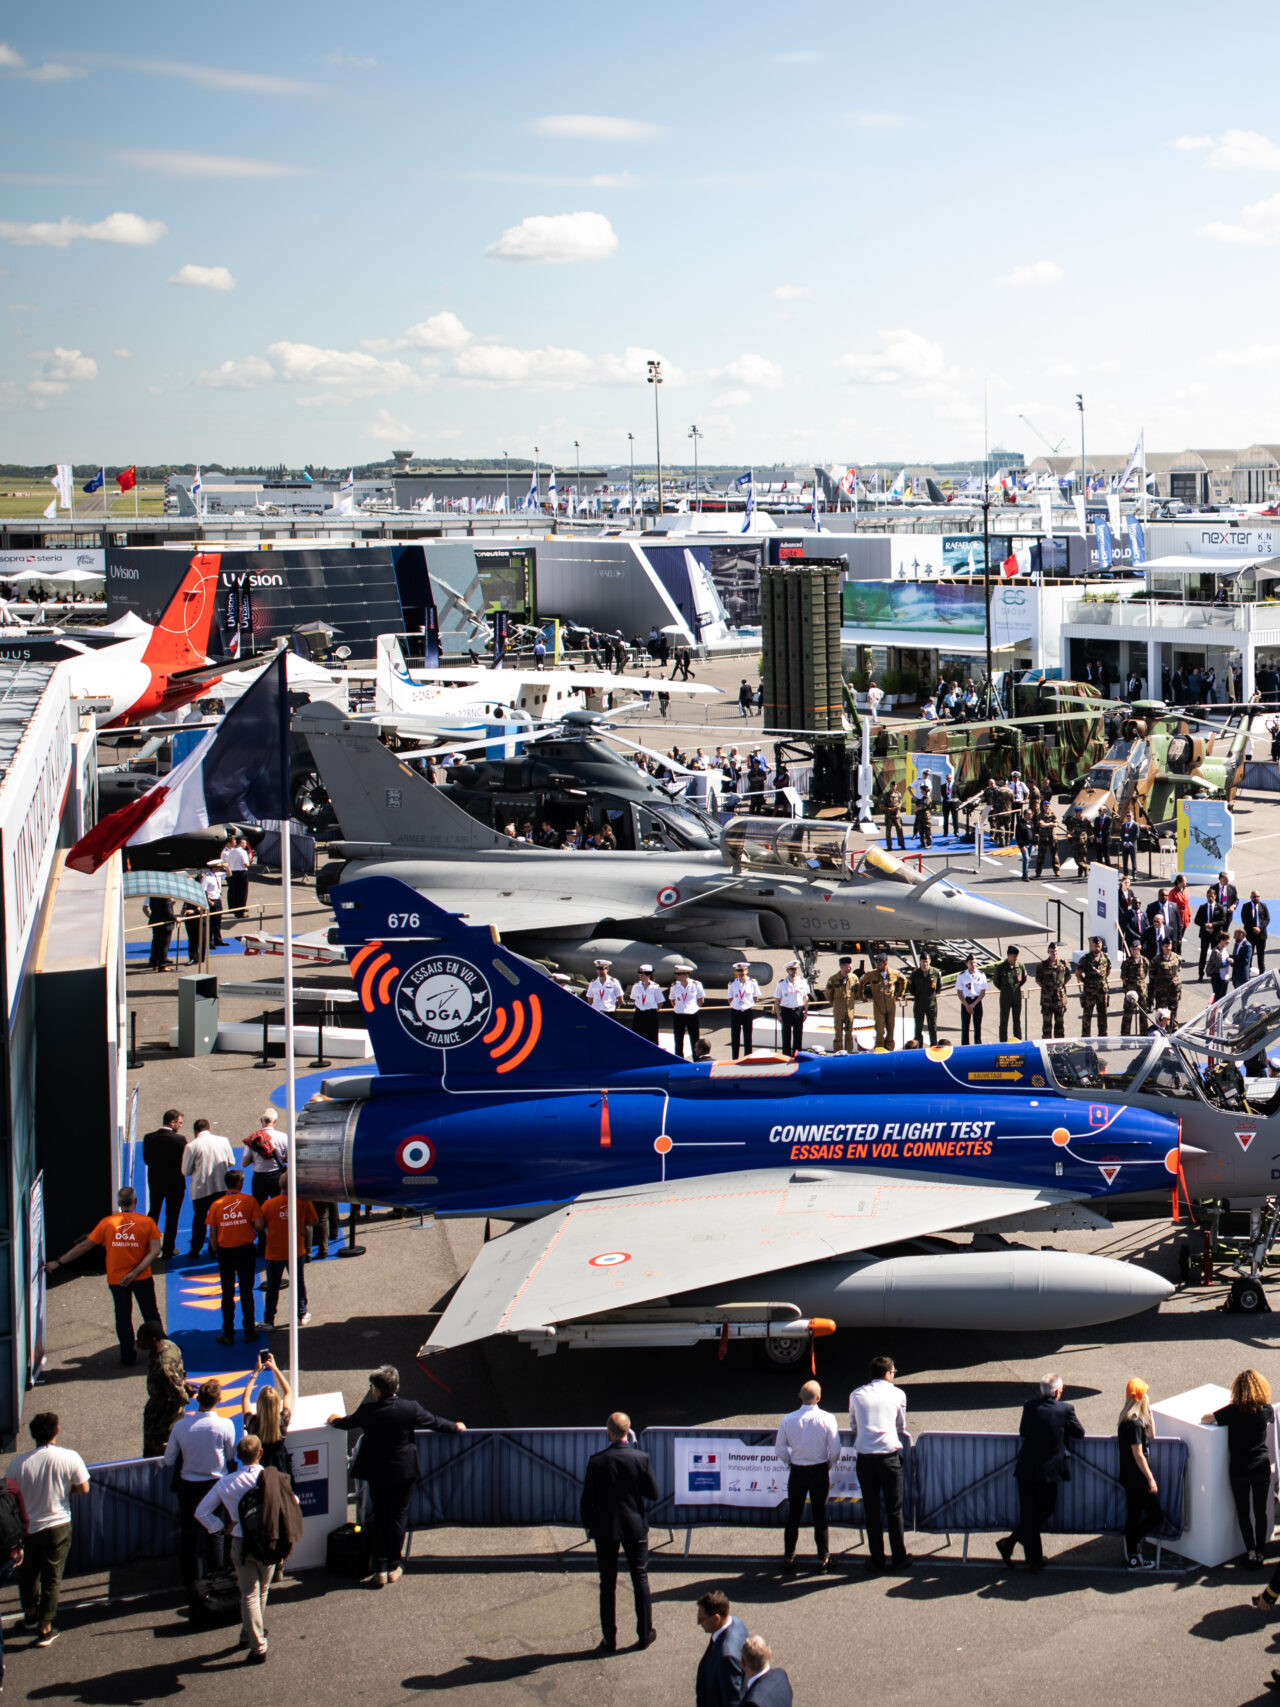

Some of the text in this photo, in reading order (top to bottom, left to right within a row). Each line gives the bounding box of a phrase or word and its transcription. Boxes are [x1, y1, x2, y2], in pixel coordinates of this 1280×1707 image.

[945, 541, 969, 550] RAFAEL
[388, 913, 420, 928] 676
[410, 962, 478, 986] ESSAIS EN VOL
[426, 1010, 462, 1020] DGA
[426, 1031, 461, 1044] FRANCE
[769, 1121, 995, 1142] CONNECTED FLIGHT TEST
[790, 1138, 993, 1160] ESSAIS EN VOL CONNECTÉS
[223, 1212, 243, 1220] DGA
[116, 1232, 136, 1240] DGA
[728, 1453, 758, 1461] Innover
[760, 1454, 778, 1463] pour
